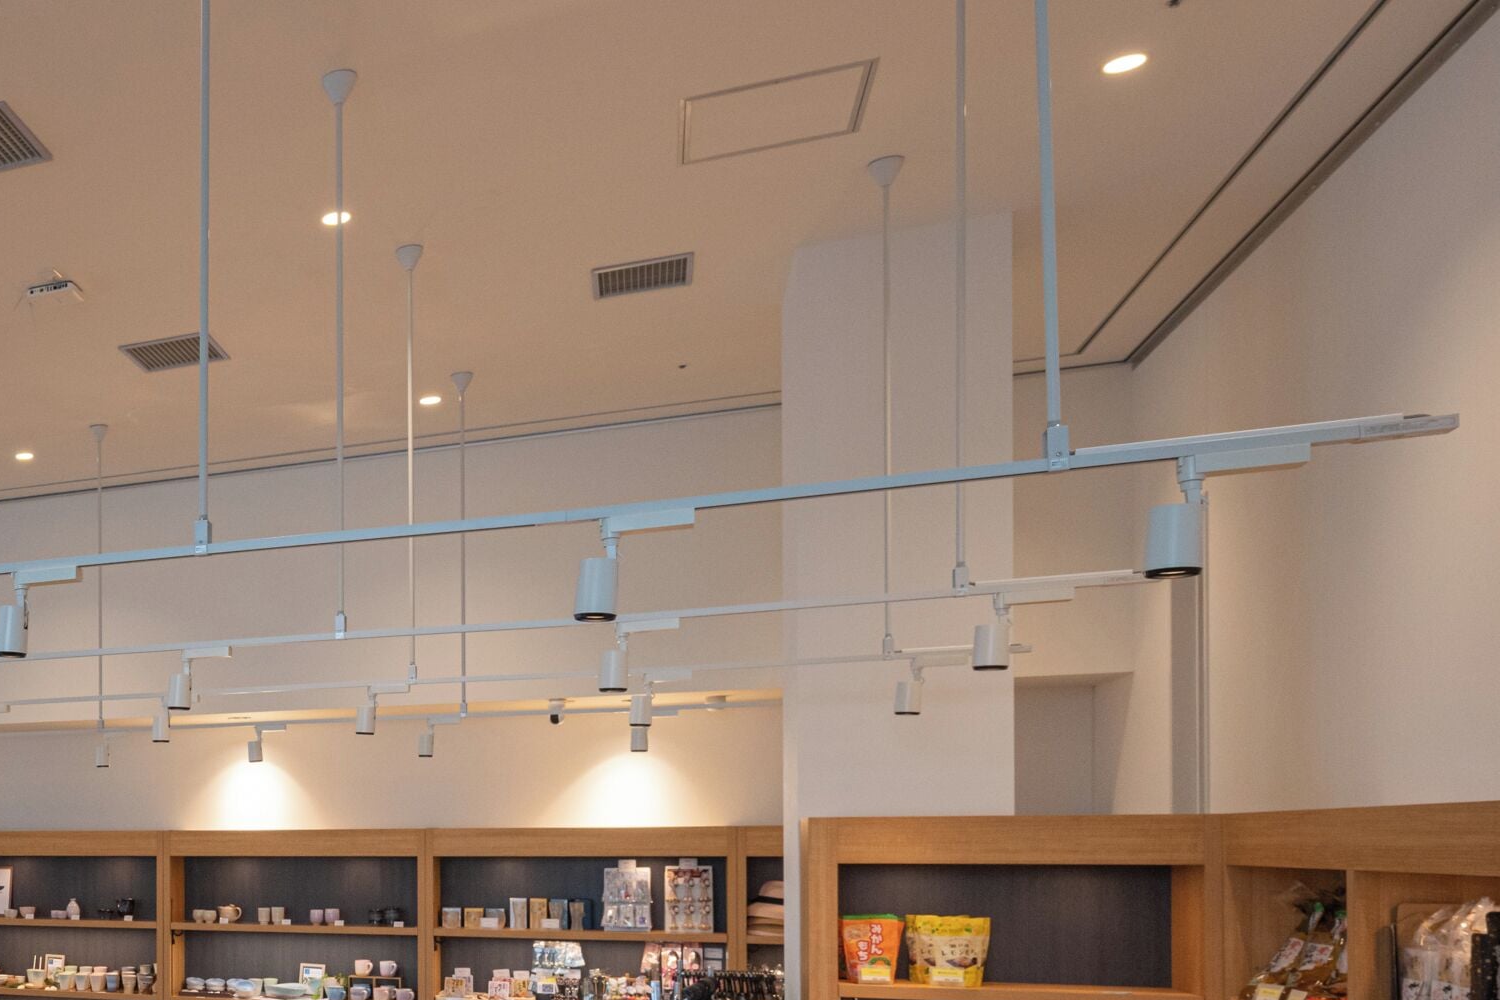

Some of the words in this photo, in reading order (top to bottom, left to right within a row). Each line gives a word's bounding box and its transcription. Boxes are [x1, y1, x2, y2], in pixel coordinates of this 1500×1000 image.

[857, 941, 869, 961] もち
[870, 923, 883, 955] みかん
